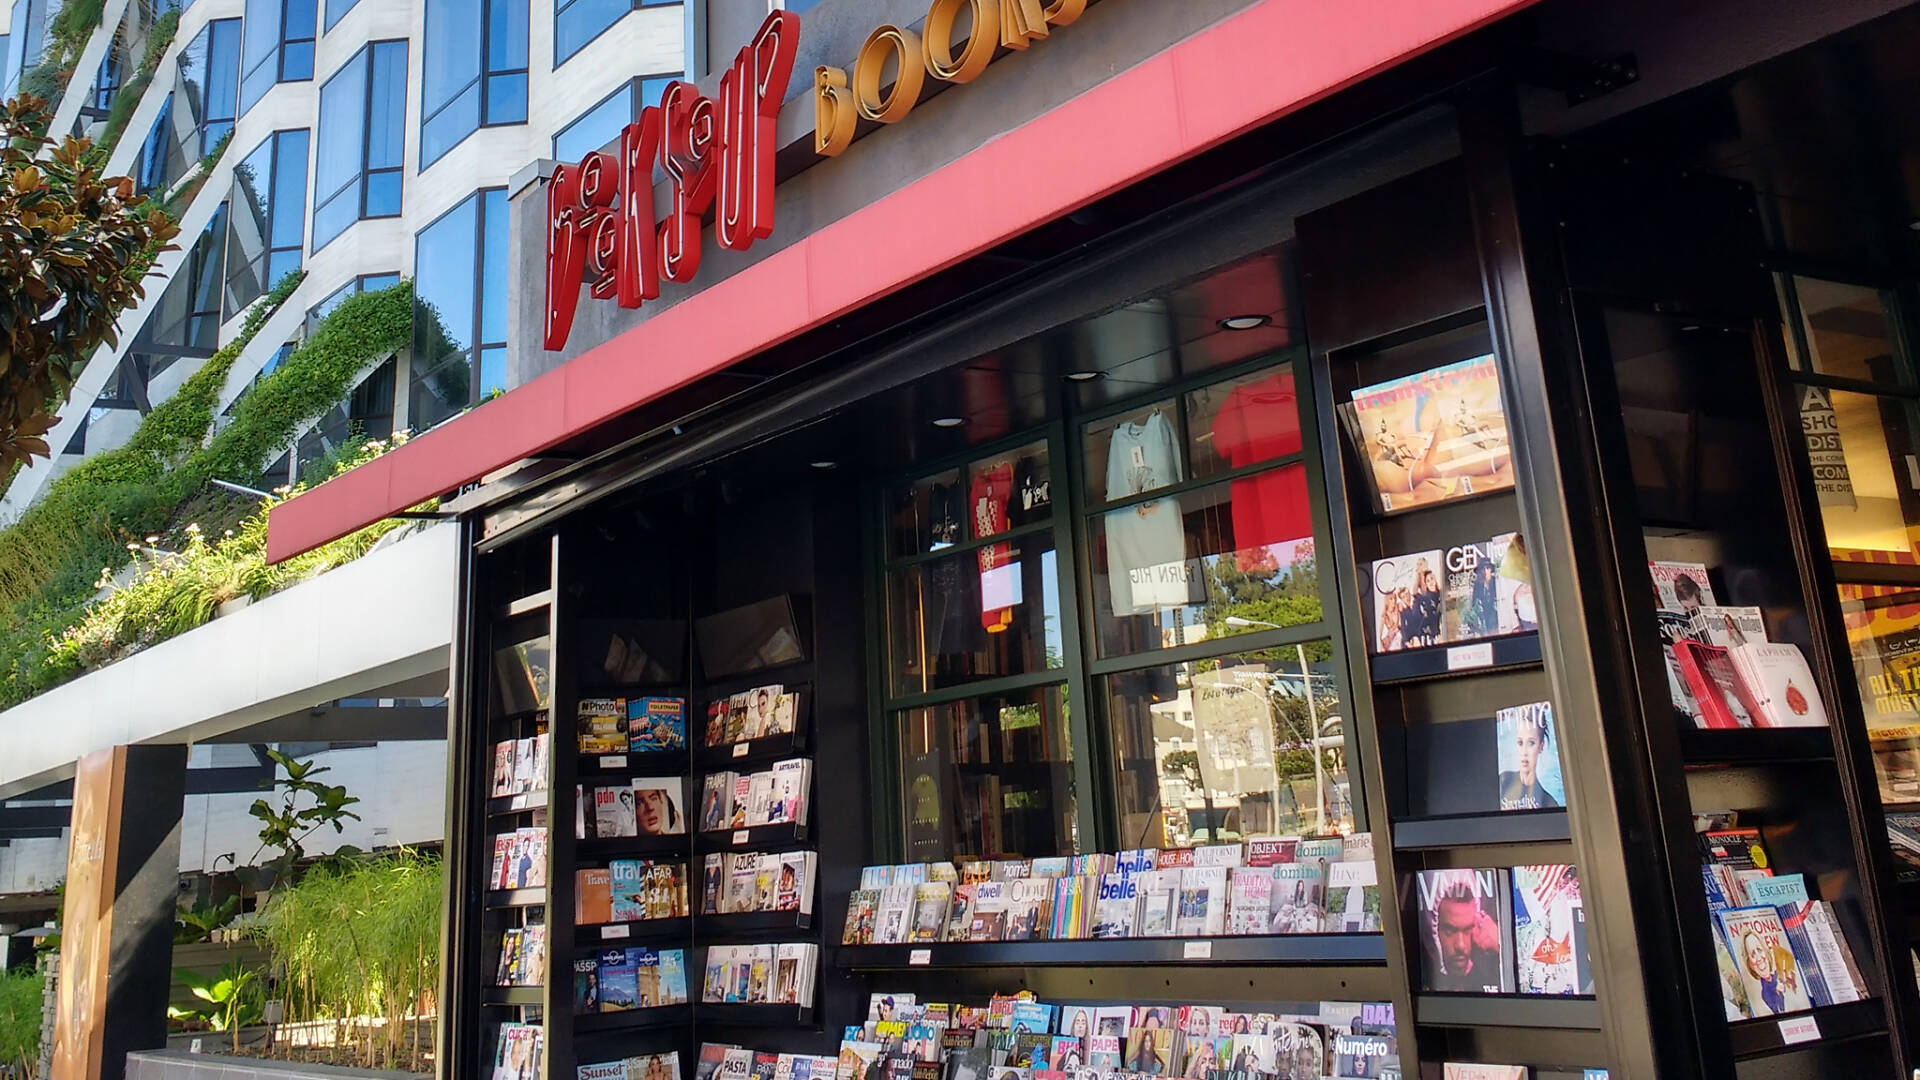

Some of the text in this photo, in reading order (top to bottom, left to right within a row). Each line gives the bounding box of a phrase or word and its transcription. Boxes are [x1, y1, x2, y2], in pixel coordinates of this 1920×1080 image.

[815, 0, 1086, 156] BOO
[597, 786, 615, 808] pdn
[1708, 834, 1742, 844] MONOCLE
[1251, 842, 1283, 855] OBJEKT
[734, 854, 756, 871] AZURE
[646, 867, 672, 880] AFAR
[977, 884, 1001, 898] dwell
[1100, 871, 1136, 899] belle
[1417, 869, 1493, 911] VMAN
[1758, 882, 1801, 898] ESCAPIST
[1336, 1037, 1388, 1056] Numéro
[580, 1063, 625, 1080] Sunset
[724, 1060, 746, 1074] PASTA
